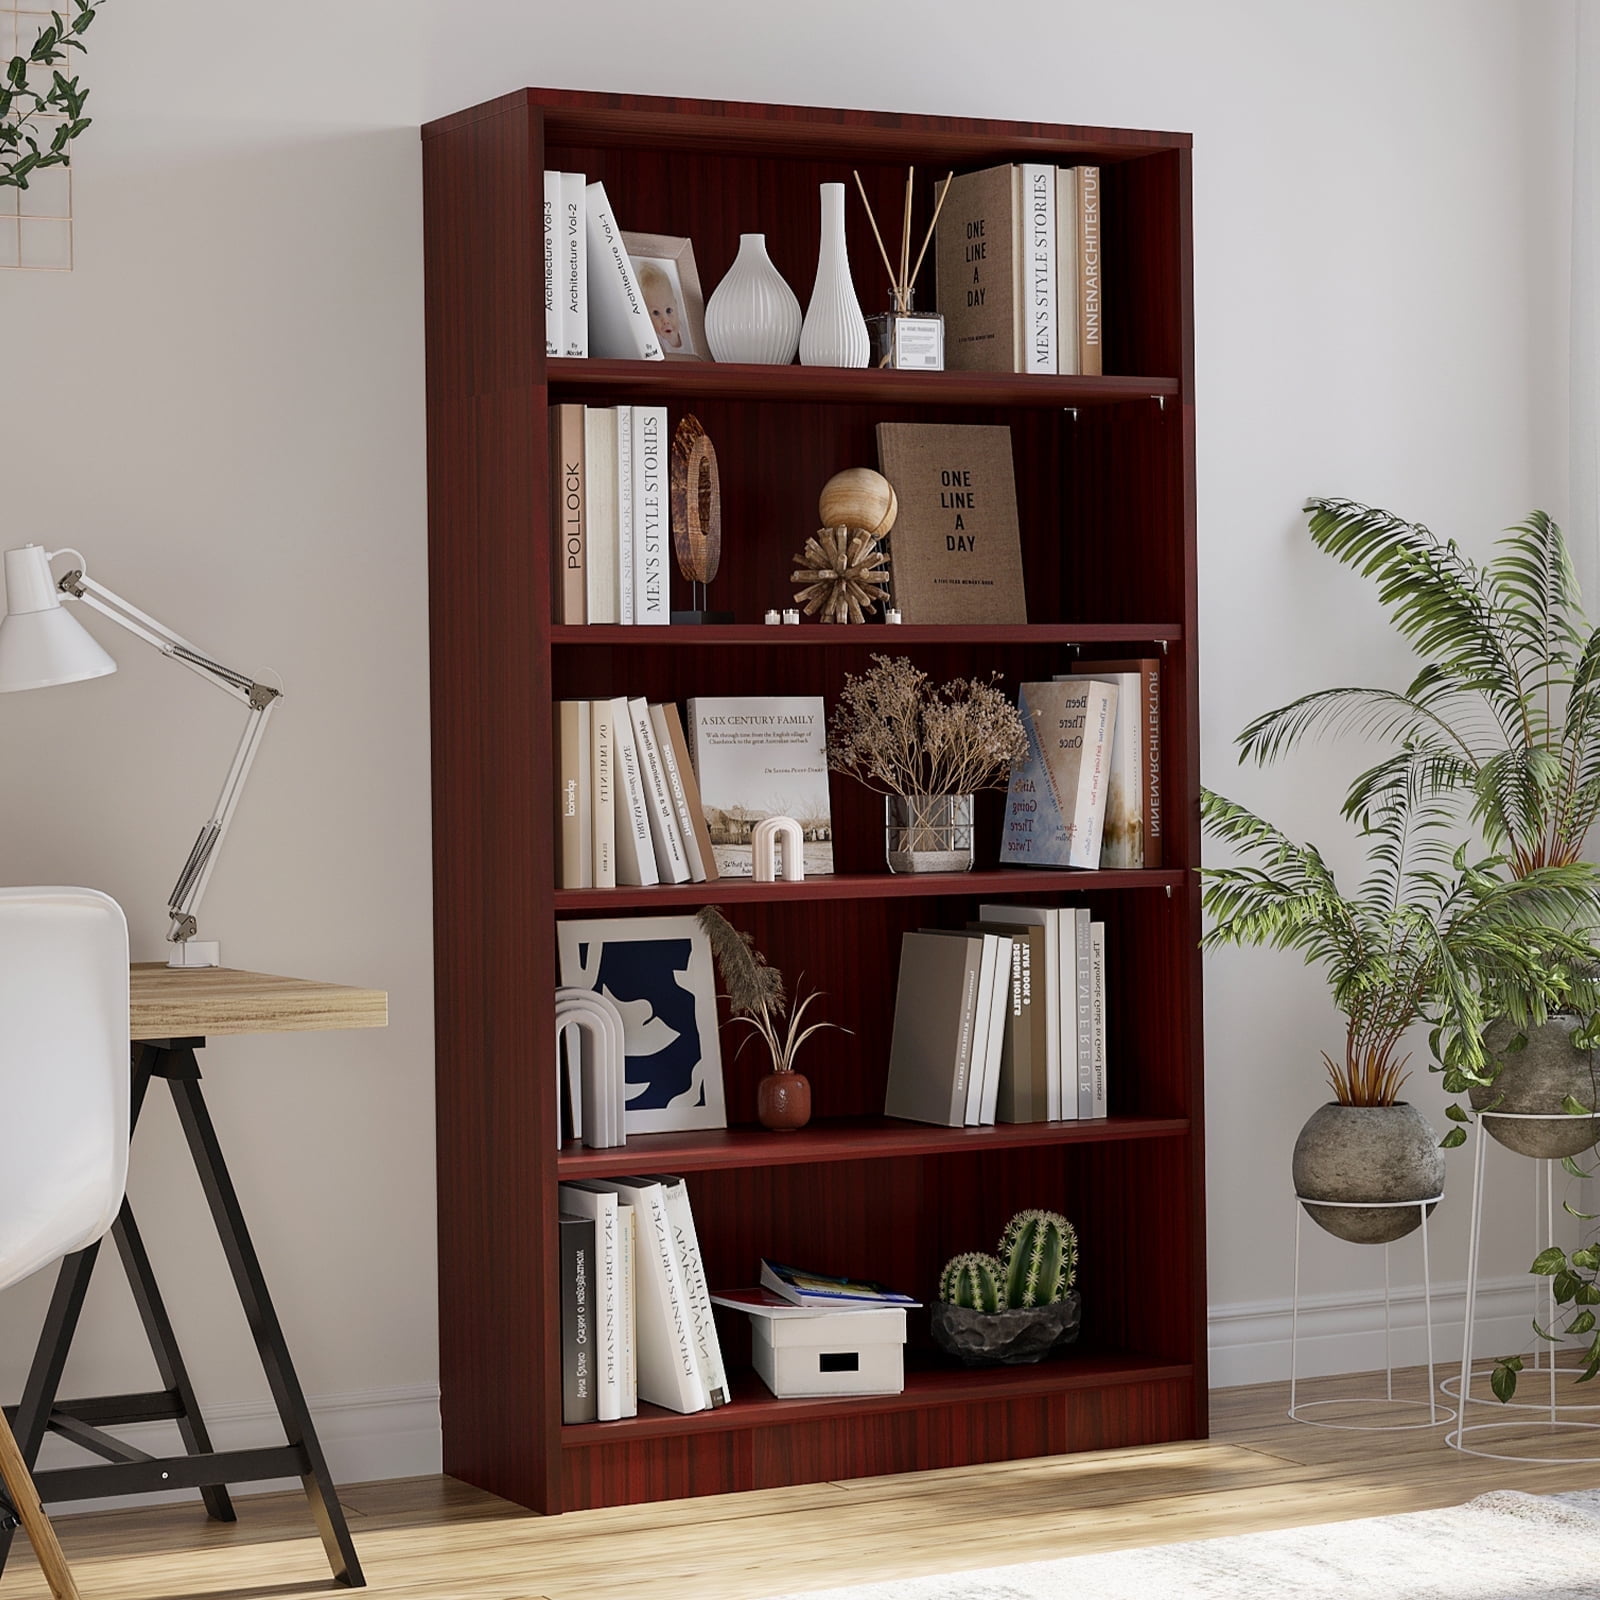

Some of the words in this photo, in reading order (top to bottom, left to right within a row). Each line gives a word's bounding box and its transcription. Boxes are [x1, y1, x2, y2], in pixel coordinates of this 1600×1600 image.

[569, 203, 577, 236] Vol-2
[599, 213, 614, 244] Vol-1
[966, 219, 986, 239] ONE
[1033, 174, 1048, 248] STORIES
[544, 238, 553, 311] Architecture
[570, 240, 578, 313] Architecture
[965, 242, 987, 263] LINE
[973, 266, 980, 284] A
[1035, 252, 1049, 308] STYLE
[1084, 166, 1099, 345] INNENARCHITEKTUR
[612, 246, 641, 315] Architecture
[967, 288, 986, 308] DAY
[1036, 311, 1050, 365] MEN'S
[622, 411, 631, 501] REVOLUTION
[644, 416, 658, 493] STORIES
[941, 470, 971, 487] ONE
[566, 461, 581, 569] POLLOCK
[623, 506, 632, 543] LOOK
[645, 497, 660, 553] STYLE
[941, 492, 975, 509] LINE
[955, 514, 965, 530] A
[624, 548, 632, 582] NEW
[946, 535, 976, 552] DAY
[646, 558, 660, 613] MEN'S
[701, 717, 708, 726] A
[710, 717, 726, 725] SIX
[727, 716, 776, 726] CENTURY
[777, 715, 815, 725] FAMILY
[604, 1207, 614, 1291] GRÜTZKE
[650, 1200, 672, 1285] GRÜTZKE
[673, 1225, 710, 1361] ДРАКОНАМИ
[606, 1293, 616, 1387] JOHANNES
[668, 1286, 694, 1378] JOHANNES
